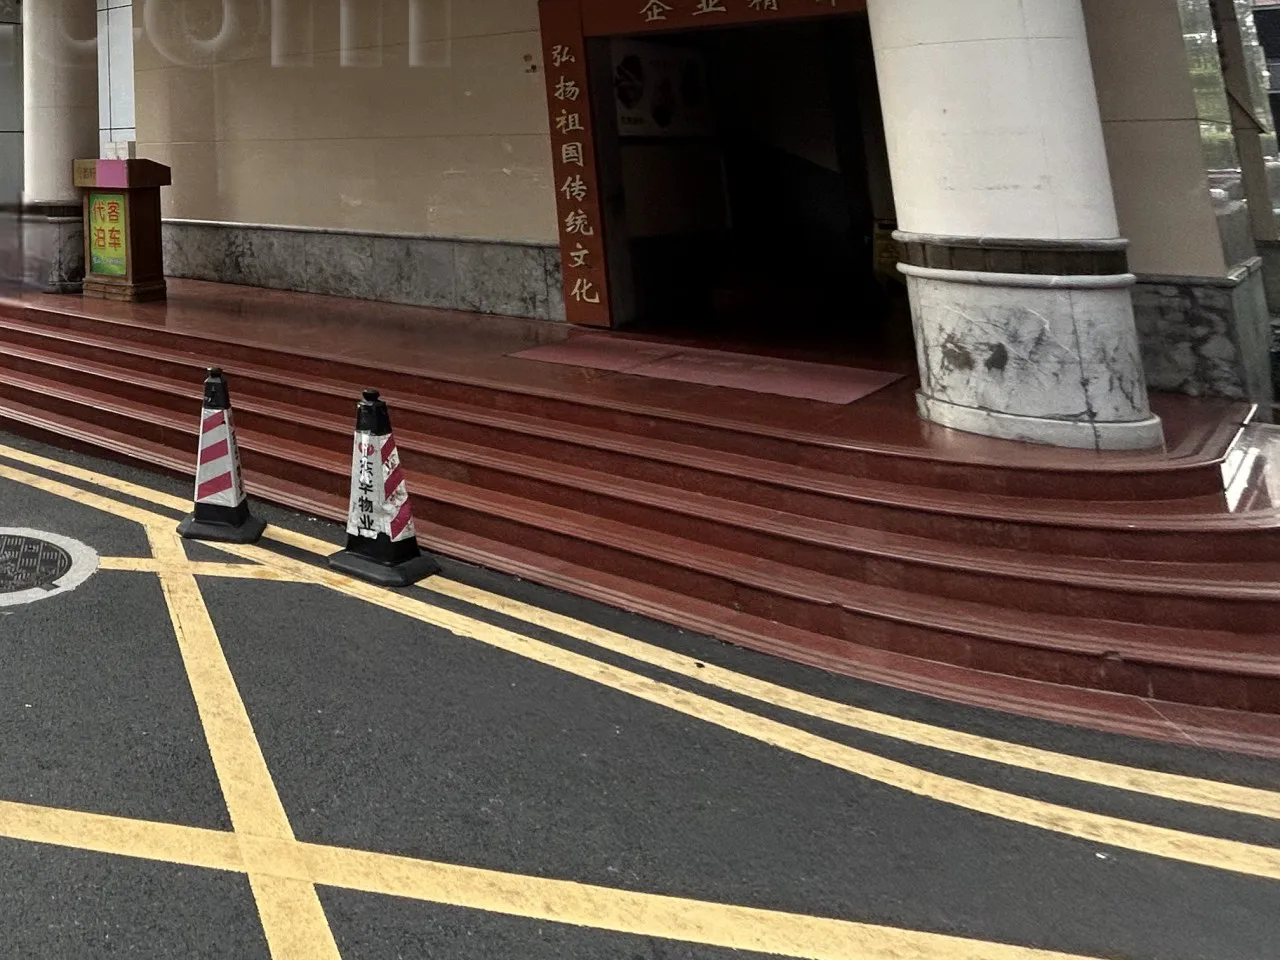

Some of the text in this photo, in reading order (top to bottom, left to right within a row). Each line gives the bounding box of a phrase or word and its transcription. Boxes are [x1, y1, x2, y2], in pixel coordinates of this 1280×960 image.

[551, 44, 601, 304] 弘扬祖国传统文化
[92, 198, 121, 224] 代客
[93, 226, 122, 252] 泊车
